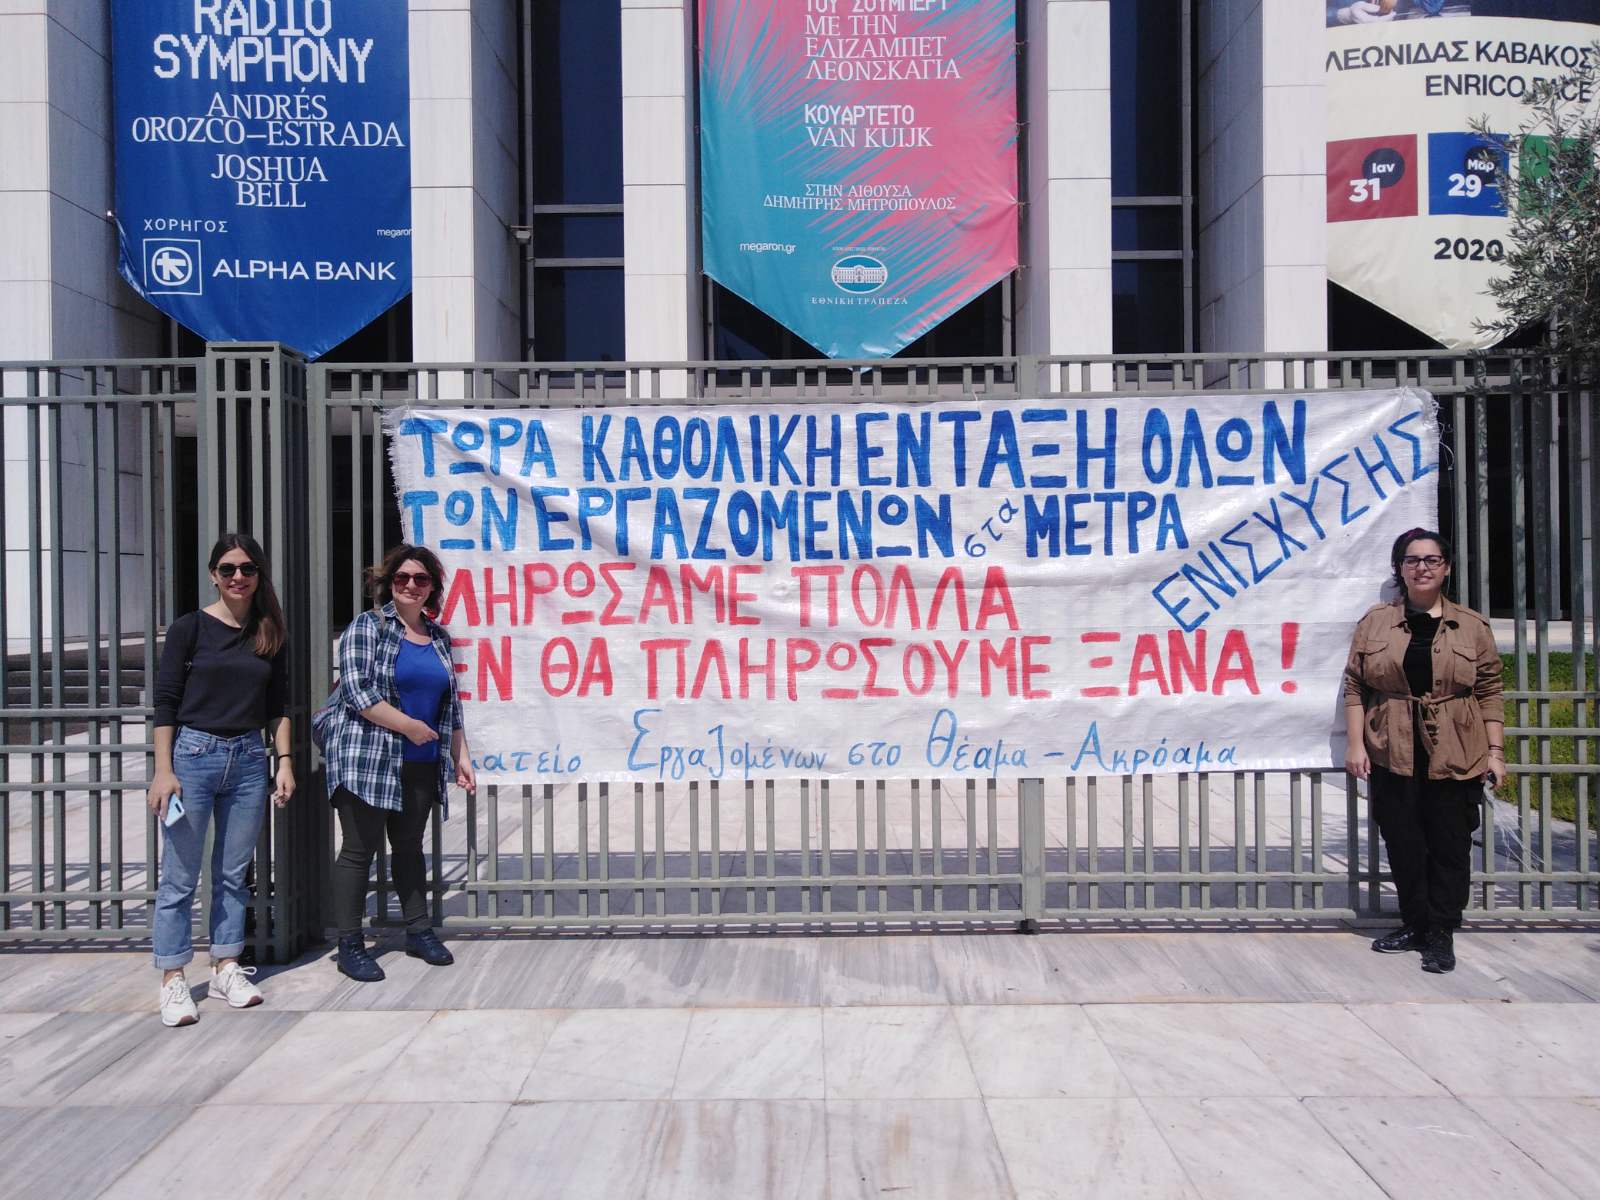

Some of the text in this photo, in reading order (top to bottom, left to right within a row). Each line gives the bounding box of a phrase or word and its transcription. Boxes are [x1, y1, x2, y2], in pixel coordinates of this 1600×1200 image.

[194, 0, 332, 36] RADIO
[805, 15, 897, 36] ΜΕ ΤΗΝ
[154, 34, 373, 83] SYMPHONY
[805, 36, 946, 58] ΕΛΙΖΑΜΠΕΤ
[1326, 41, 1592, 71] ΛΕΩΝΙΔΑΣ ΚΑΒΑΚΟΣ
[1426, 74, 1525, 97] ENRICO
[206, 87, 328, 120] ANDRÉS
[804, 104, 914, 125] ΚΟΥΑΡΤΕΤΟ
[805, 127, 934, 147] VAN KUIJK
[211, 154, 328, 182] JOSHUA
[236, 182, 306, 208] BELL
[805, 184, 912, 198] ΣΤΗΝ ΑΙΘΟΥΣΑ
[1349, 178, 1381, 202] 31
[1448, 173, 1482, 198] 29
[143, 218, 229, 233] ΧΟΡΗΓΟΣ
[739, 242, 796, 254] megaron.gr
[1434, 237, 1505, 262] 2020
[212, 258, 397, 281] ALPHA BANK
[400, 400, 1307, 488] ΤΩΡΑ ΚΑΘΟΛΙΚΗ ΕΝΤΑΞΗ ΟΛΩΝ
[402, 486, 518, 551] ΤΩΝ
[1024, 491, 1189, 558] ΜΕΤΡΑ
[1151, 410, 1438, 633] ΕΝΙΣΧΥΣΗΣ
[438, 561, 1019, 631] ΛΗΡΩΣΑΜΕ ΠΟΛΛΑ
[450, 635, 513, 702] ΕΝ
[540, 636, 613, 698] ΘΑ
[640, 635, 1052, 701] ΠΛΗΡΩΣΟΥΜΕ
